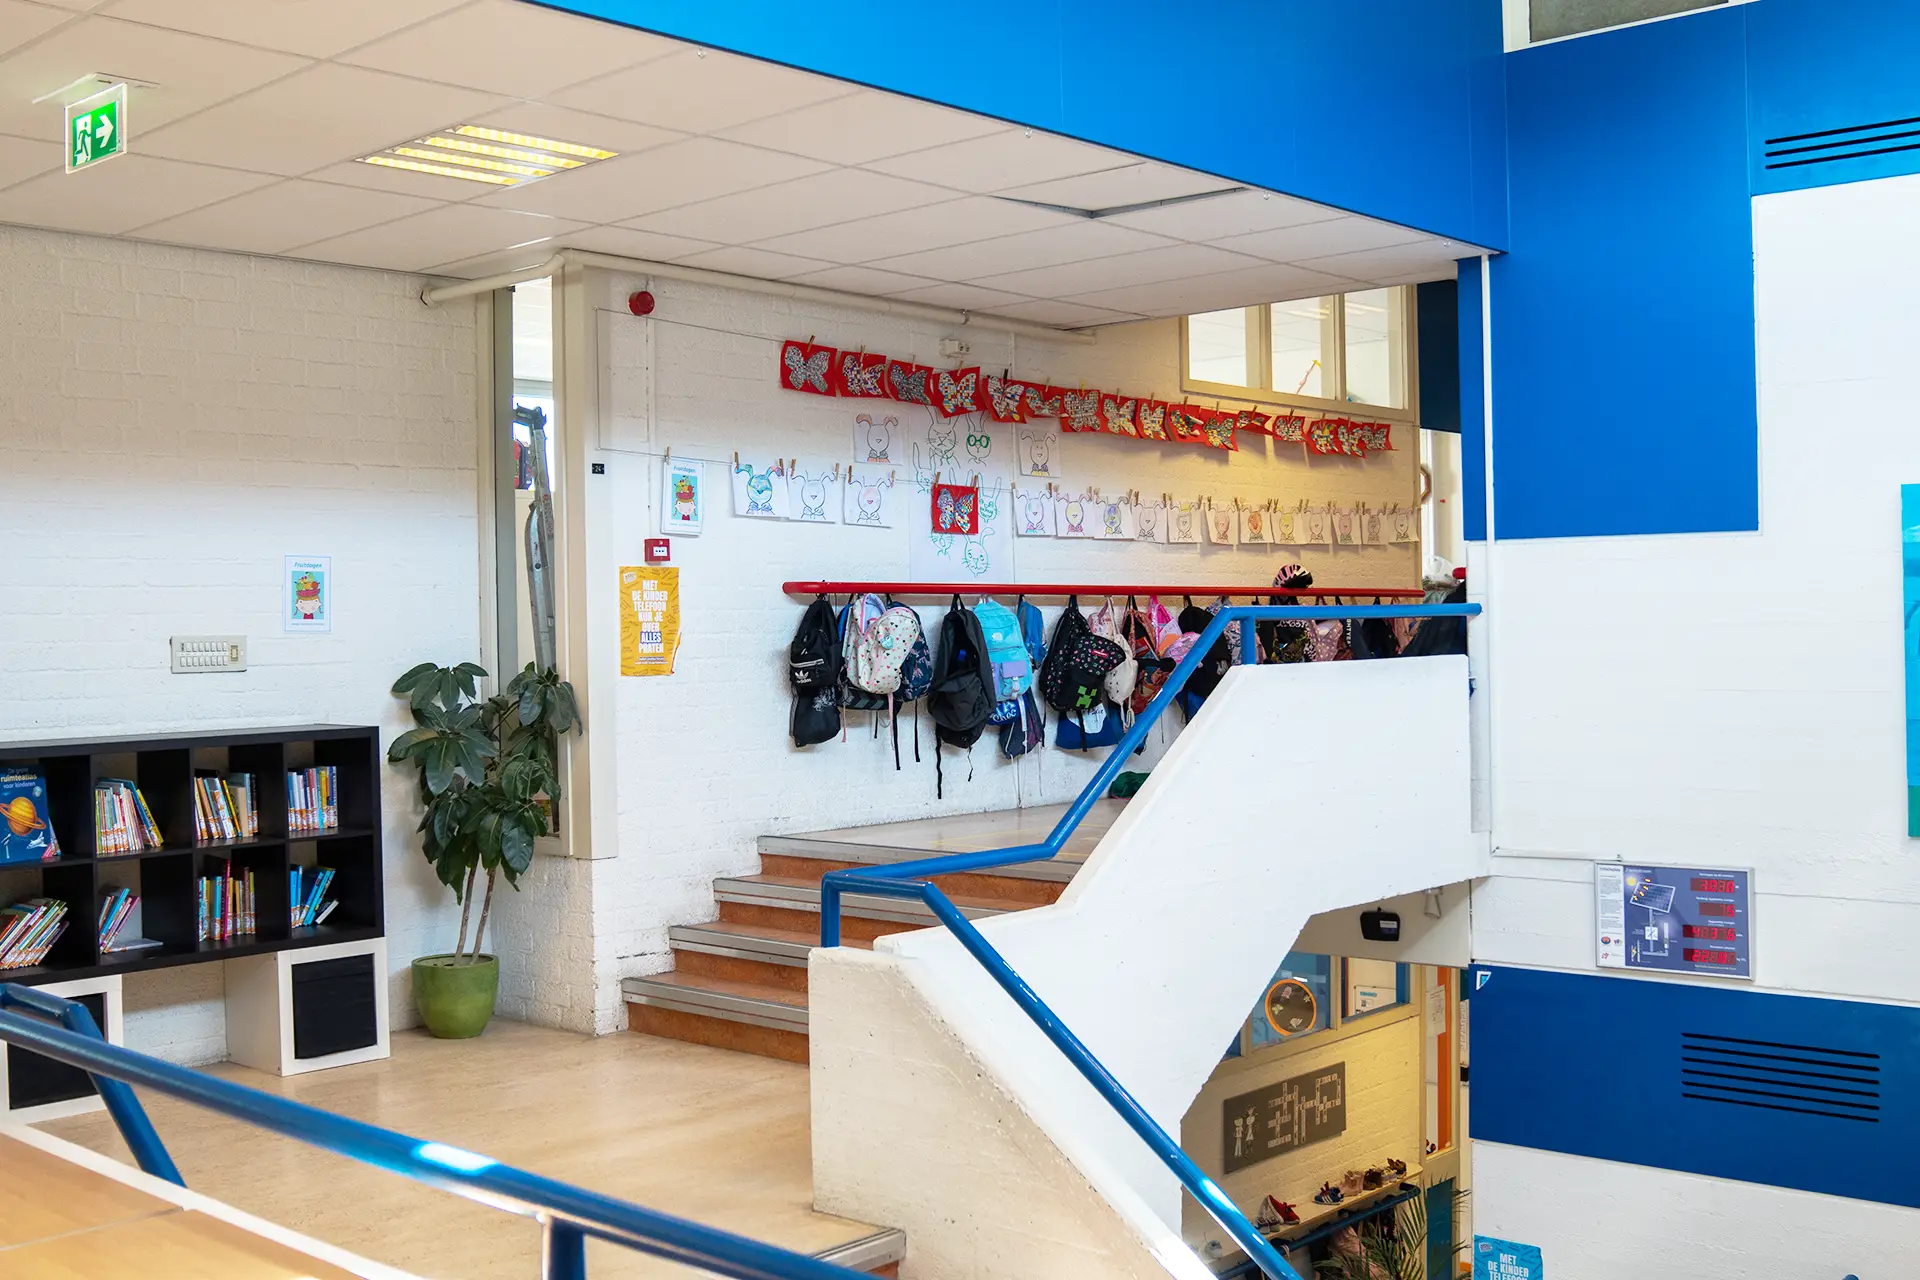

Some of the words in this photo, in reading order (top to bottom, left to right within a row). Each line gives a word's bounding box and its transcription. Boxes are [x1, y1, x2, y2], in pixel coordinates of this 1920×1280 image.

[642, 580, 658, 590] MET
[632, 590, 641, 600] DE
[643, 590, 668, 601] KINDER
[633, 601, 666, 611] TELEFOON
[638, 611, 652, 621] KUN
[654, 612, 663, 622] JE
[642, 622, 660, 632] OVER
[641, 632, 662, 643] ALLES
[638, 643, 664, 654] PRATEN
[1, 774, 37, 782] ruimteatlas
[1500, 1253, 1516, 1265] MET
[1488, 1261, 1498, 1271] DE
[1500, 1263, 1529, 1277] KINDER
